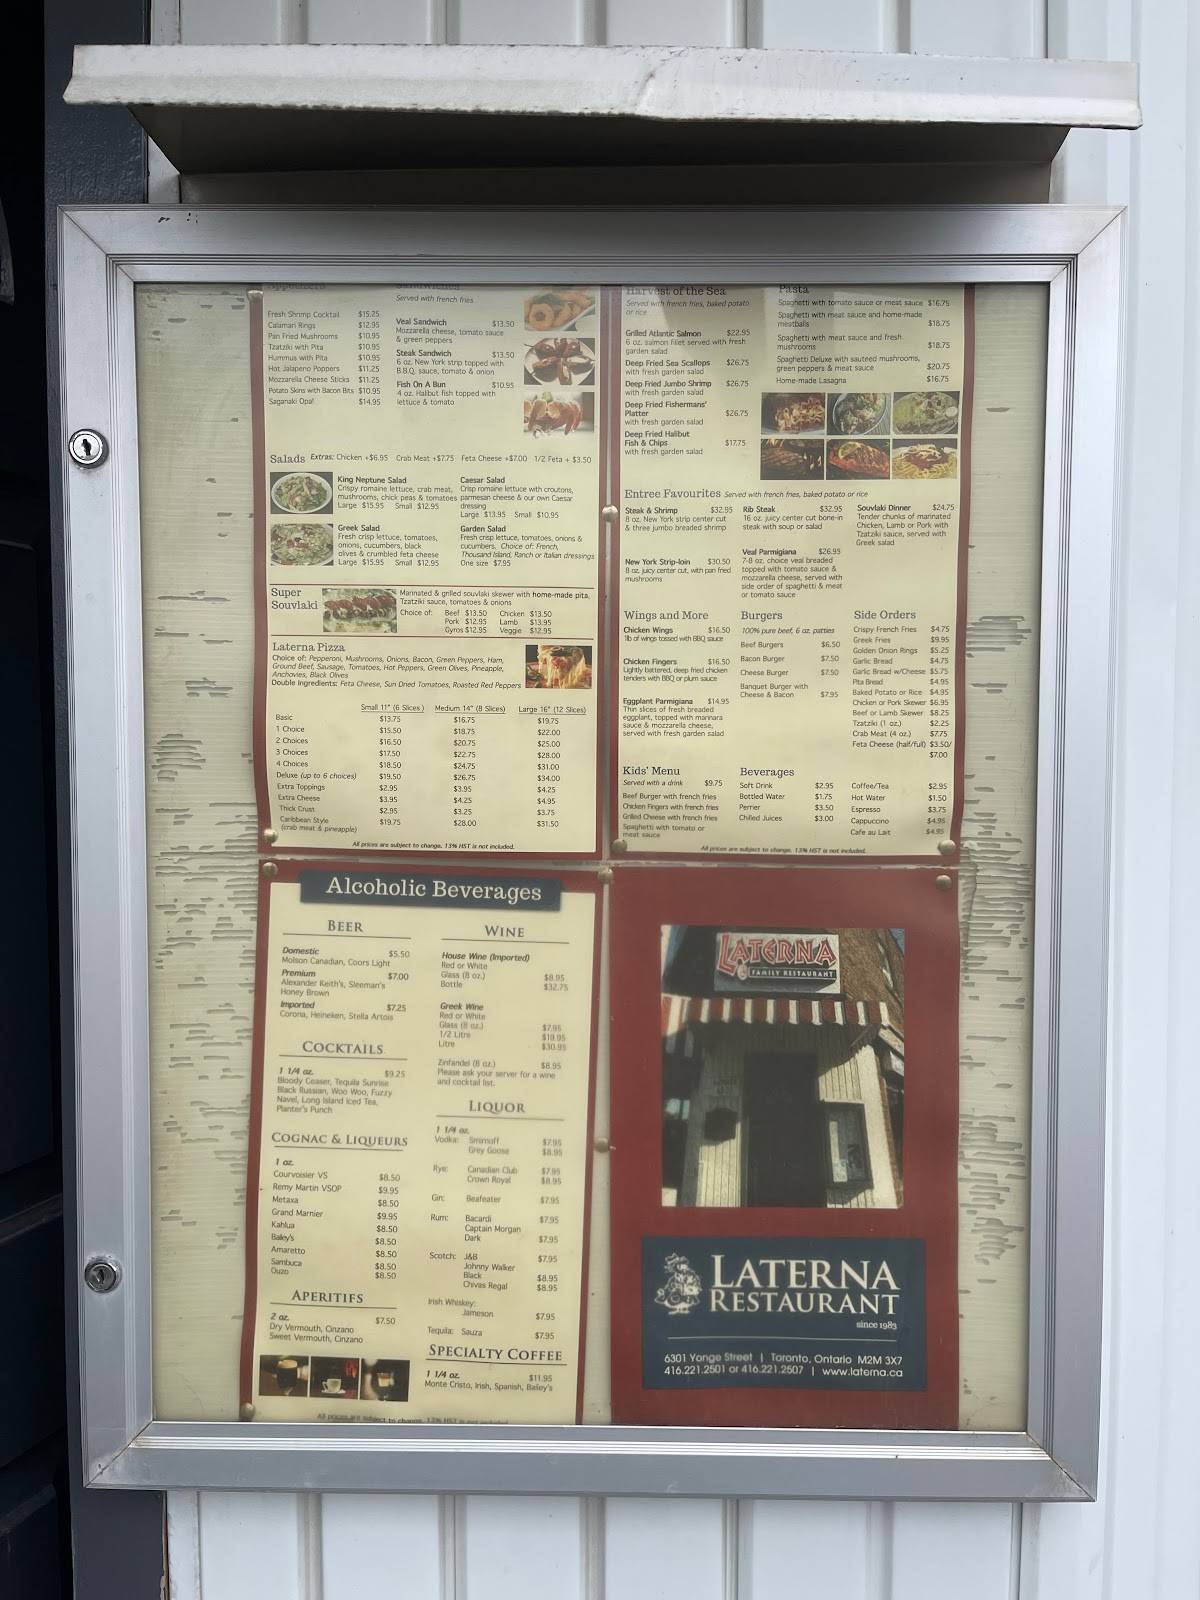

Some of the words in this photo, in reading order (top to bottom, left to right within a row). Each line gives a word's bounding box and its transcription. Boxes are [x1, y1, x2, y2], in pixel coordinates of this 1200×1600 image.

[672, 287, 683, 296] of
[686, 287, 703, 296] the
[706, 287, 726, 296] Sea
[396, 318, 412, 326] Veal
[413, 318, 447, 326] Sandwich
[492, 320, 515, 328] $13.50
[491, 351, 515, 359] $13.50
[681, 359, 711, 367] Scallops
[282, 365, 312, 373] Jalapeno
[313, 365, 340, 373] Poppers
[358, 365, 380, 373] $11.25
[358, 376, 380, 384] $11.25
[491, 381, 515, 389] $10.95
[819, 377, 847, 385] Lasagna
[926, 375, 949, 383] $16.75
[269, 453, 306, 464] Salads
[310, 453, 335, 462] Extras:
[335, 453, 363, 462] Chicken
[365, 454, 389, 462] +$6.95
[337, 475, 354, 485] King
[355, 475, 386, 485] Neptune
[387, 476, 407, 484] Salad
[460, 476, 483, 484] Caesar
[484, 476, 506, 484] Salad
[624, 489, 661, 500] Entree
[663, 488, 721, 499] Favourites
[624, 506, 645, 515] Steak
[646, 506, 652, 515] &
[653, 506, 679, 516] Shrimp
[710, 505, 733, 514] $32.95
[742, 505, 754, 514] Rib
[755, 505, 776, 514] Steak
[819, 505, 843, 513] $32.95
[856, 504, 886, 513] Souvlaki
[887, 504, 911, 512] Dinner
[932, 503, 955, 512] $24.75
[337, 524, 359, 533] Greek
[361, 524, 380, 533] Salad
[460, 524, 485, 533] Garden
[486, 524, 507, 533] Salad
[624, 558, 641, 566] New
[642, 558, 657, 566] York
[659, 558, 691, 568] Strip-loin
[707, 558, 731, 567] $30.50
[271, 587, 302, 600] Super
[271, 599, 319, 611] Souvlaki
[624, 610, 656, 622] Wings
[658, 610, 679, 621] and
[681, 610, 709, 621] More
[740, 610, 783, 622] Burgers
[853, 609, 876, 621] Side
[879, 609, 916, 621] Orders
[623, 626, 651, 635] Chicken
[651, 626, 673, 636] Wings
[707, 625, 731, 635] $16.50
[852, 625, 874, 635] Crispy
[875, 625, 898, 633] French
[899, 625, 917, 633] Fries
[930, 625, 950, 634] $4.75
[271, 642, 315, 653] Laterna
[316, 642, 346, 653] Pizza
[740, 640, 758, 649] Beef
[759, 640, 784, 651] Burgers
[820, 640, 841, 649] $6.50
[275, 713, 293, 722] Basic
[379, 715, 401, 724] $13.75
[453, 716, 476, 724] $16.75
[537, 716, 559, 726] $19.75
[275, 725, 281, 733] 1
[282, 725, 305, 733] Choice
[379, 726, 402, 735] $15.50
[453, 727, 476, 736] $18.75
[537, 728, 561, 737] $22.00
[622, 765, 649, 777] Kids'
[651, 766, 681, 777] Menu
[739, 767, 795, 779] Beverages
[739, 781, 754, 790] Soft
[755, 782, 773, 790] Drink
[814, 781, 834, 790] $2.95
[851, 782, 889, 791] Coffee/Tea
[928, 782, 948, 791] $2.95
[739, 792, 764, 801] Bottled
[765, 792, 786, 801] Water
[814, 792, 833, 801] $1.75
[851, 794, 864, 802] Hot
[865, 794, 886, 802] Water
[927, 794, 947, 802] $1.50
[325, 876, 427, 898] Alcoholic
[432, 880, 542, 905] Beverages
[327, 919, 364, 933] BEER
[484, 925, 526, 939] WINE
[282, 946, 320, 956] Domestic
[388, 950, 410, 959] $5.50
[717, 932, 837, 978] LATERNA
[281, 956, 308, 965] Molson
[309, 957, 345, 967] Canadian,
[347, 957, 370, 967] Coors
[371, 958, 391, 969] Light
[281, 969, 316, 978] Premium
[387, 972, 409, 982] $7.00
[751, 969, 781, 977] FAMILY
[783, 969, 835, 978] RESTAURANT
[302, 1040, 384, 1055] COCKTAILS
[468, 1100, 526, 1116] LIQUOR
[271, 1132, 328, 1145] COGNAC
[331, 1134, 342, 1145] &
[346, 1135, 409, 1148] LIQUEURS
[273, 1169, 315, 1180] Courvoisier
[317, 1170, 328, 1180] VS
[379, 1173, 401, 1183] $8.50
[272, 1183, 293, 1193] Remy
[295, 1184, 320, 1193] Martin
[321, 1184, 342, 1193] VSOP
[378, 1186, 400, 1195] $9.95
[464, 1224, 493, 1234] Captain
[494, 1225, 521, 1234] Morgan
[710, 1254, 901, 1291] LATERNA
[291, 1290, 365, 1304] APERITIFS
[709, 1289, 900, 1315] RESTAURANT
[856, 1320, 879, 1329] since
[879, 1321, 898, 1330] 1983
[429, 1344, 503, 1360] SPECIALTY
[507, 1348, 563, 1362] COFFEE
[664, 1354, 687, 1363] 6301
[689, 1353, 722, 1365] Yonge
[724, 1353, 753, 1363] Street
[770, 1354, 812, 1364] Toronto,
[814, 1354, 852, 1365] Ontario
[857, 1355, 883, 1366] M2M
[884, 1355, 903, 1366] 3X7
[663, 1365, 726, 1376] 416.221.2501
[728, 1366, 739, 1375] or
[741, 1365, 804, 1375] 416.221.2507
[822, 1367, 904, 1378] www.laterna.ca
